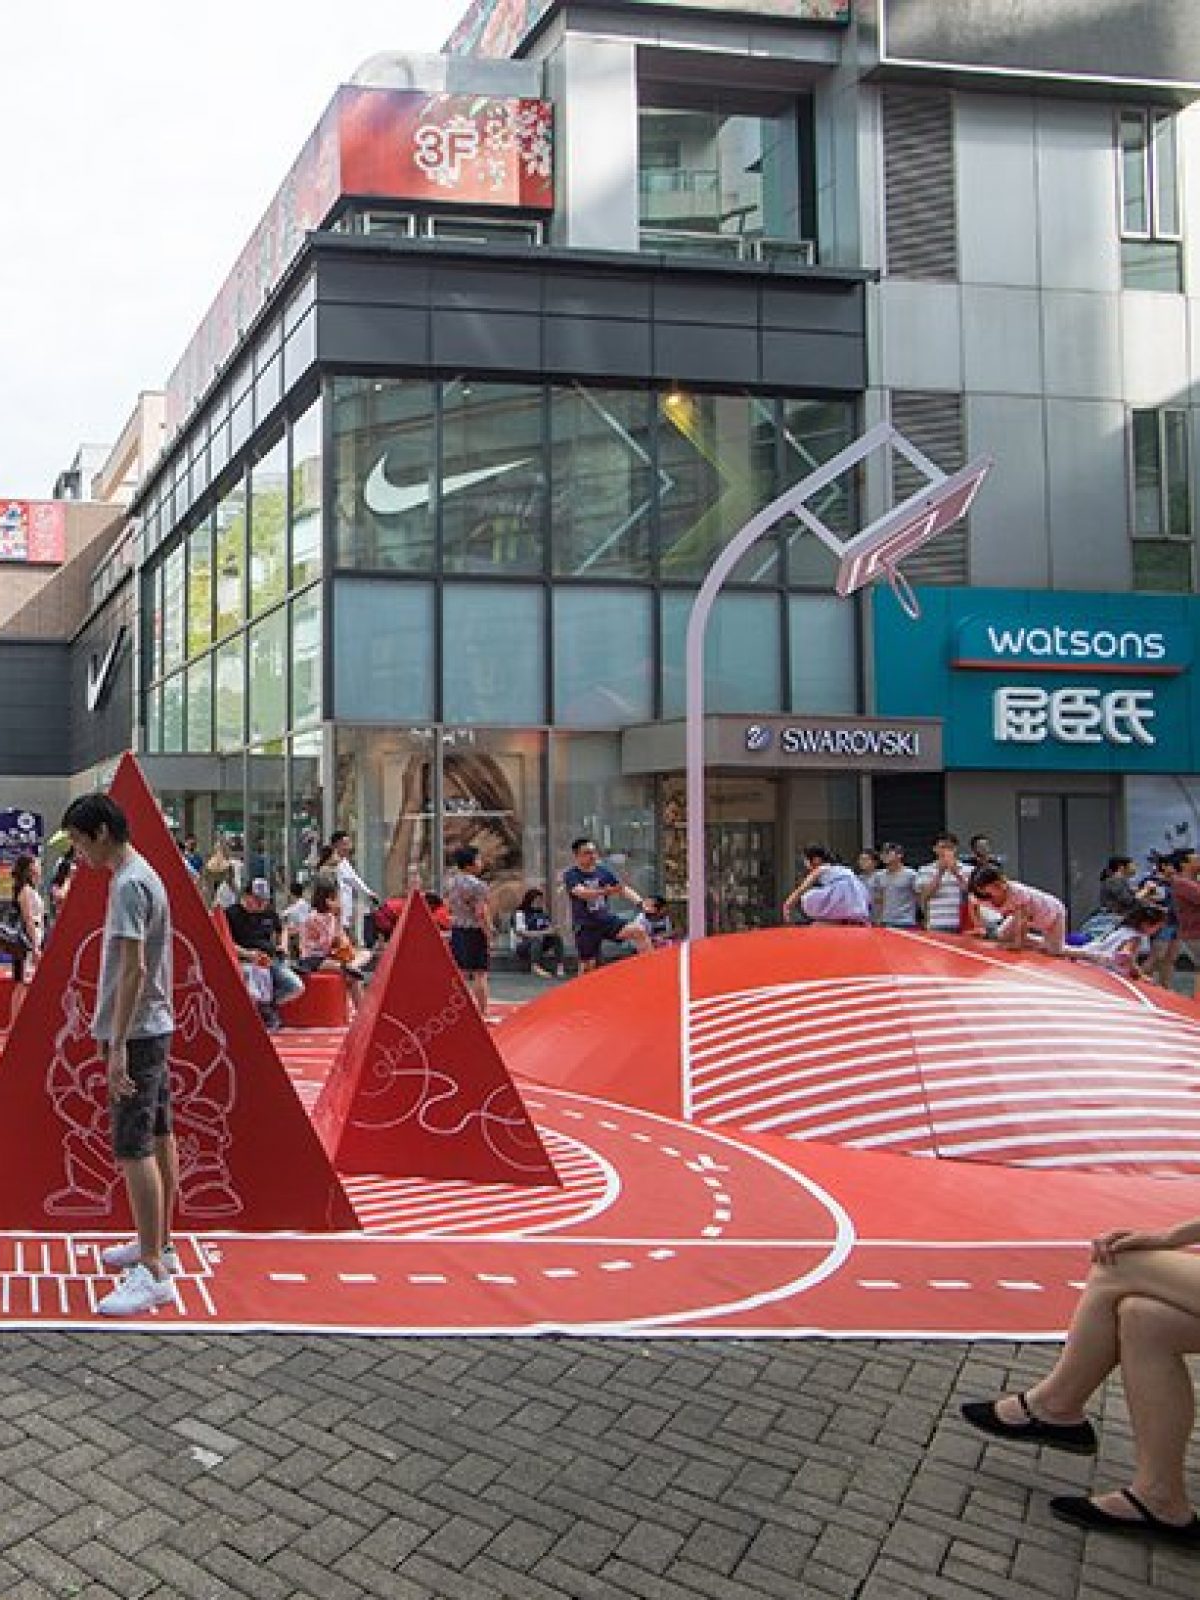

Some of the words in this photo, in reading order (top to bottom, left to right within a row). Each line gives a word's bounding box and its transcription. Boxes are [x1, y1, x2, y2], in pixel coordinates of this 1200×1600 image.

[414, 126, 478, 172] 3F
[988, 625, 1166, 658] watsons
[994, 687, 1155, 744] 屈臣氏
[782, 728, 919, 755] SWAROVSKI
